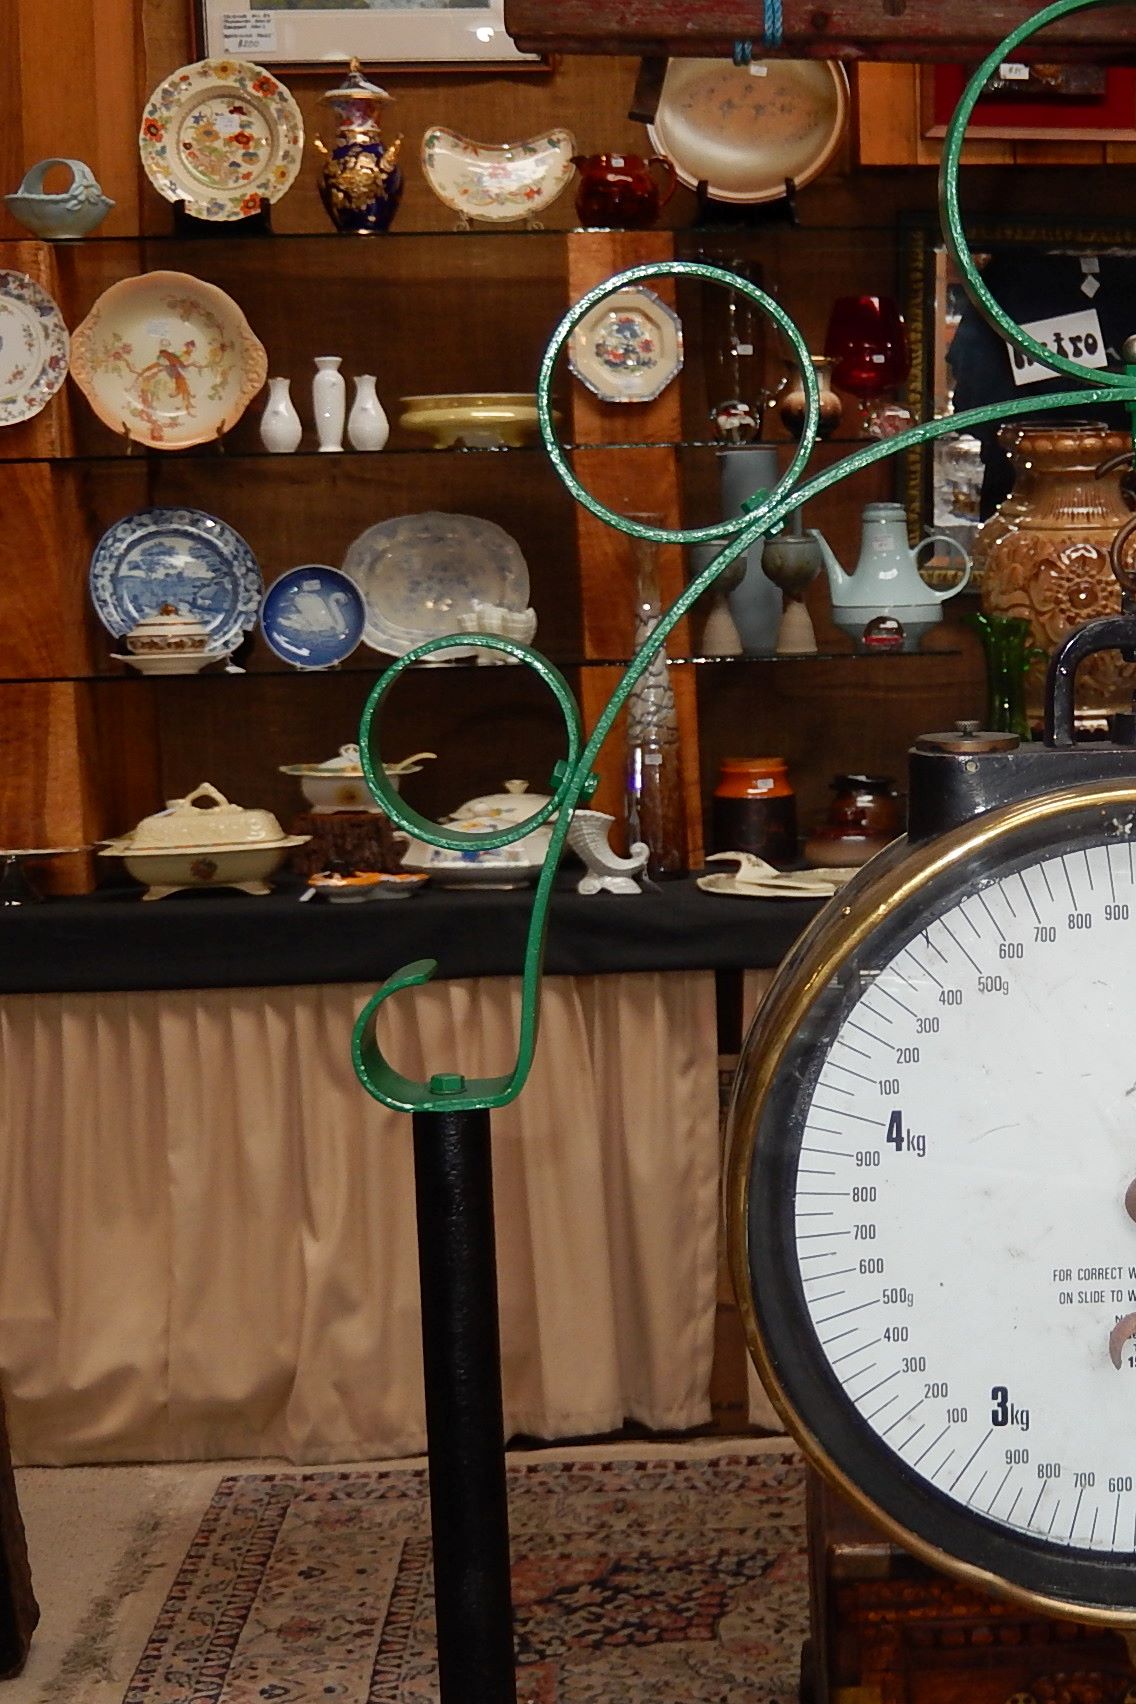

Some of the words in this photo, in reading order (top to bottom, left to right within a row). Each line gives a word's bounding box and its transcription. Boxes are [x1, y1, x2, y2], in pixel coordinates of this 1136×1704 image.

[1105, 905, 1128, 920] 900
[1068, 913, 1091, 929] 800
[1034, 927, 1056, 942] 700
[999, 943, 1023, 959] 600
[978, 976, 1008, 995] 500g
[939, 989, 962, 1005] 400
[916, 1017, 939, 1033] 300
[896, 1047, 919, 1064] 200
[878, 1079, 899, 1095] 100
[886, 1109, 927, 1158] 4kg
[856, 1151, 880, 1167] 900
[853, 1187, 876, 1202] 800
[854, 1224, 876, 1240] 700
[860, 1258, 883, 1274] 600
[1053, 1268, 1072, 1282] FOR
[1077, 1267, 1123, 1281] CORRECT
[883, 1288, 913, 1307] 500g
[1059, 1291, 1073, 1305] ON
[1077, 1290, 1106, 1304] SLIDE
[1110, 1289, 1123, 1302] TO
[884, 1327, 908, 1342] 400
[902, 1357, 926, 1373] 300
[925, 1383, 948, 1399] 200
[947, 1408, 967, 1423] 100
[990, 1385, 1031, 1432] 3kg
[1005, 1449, 1029, 1465] 900
[1038, 1463, 1060, 1479] 800
[1074, 1472, 1095, 1488] 700
[1109, 1477, 1132, 1493] 600
